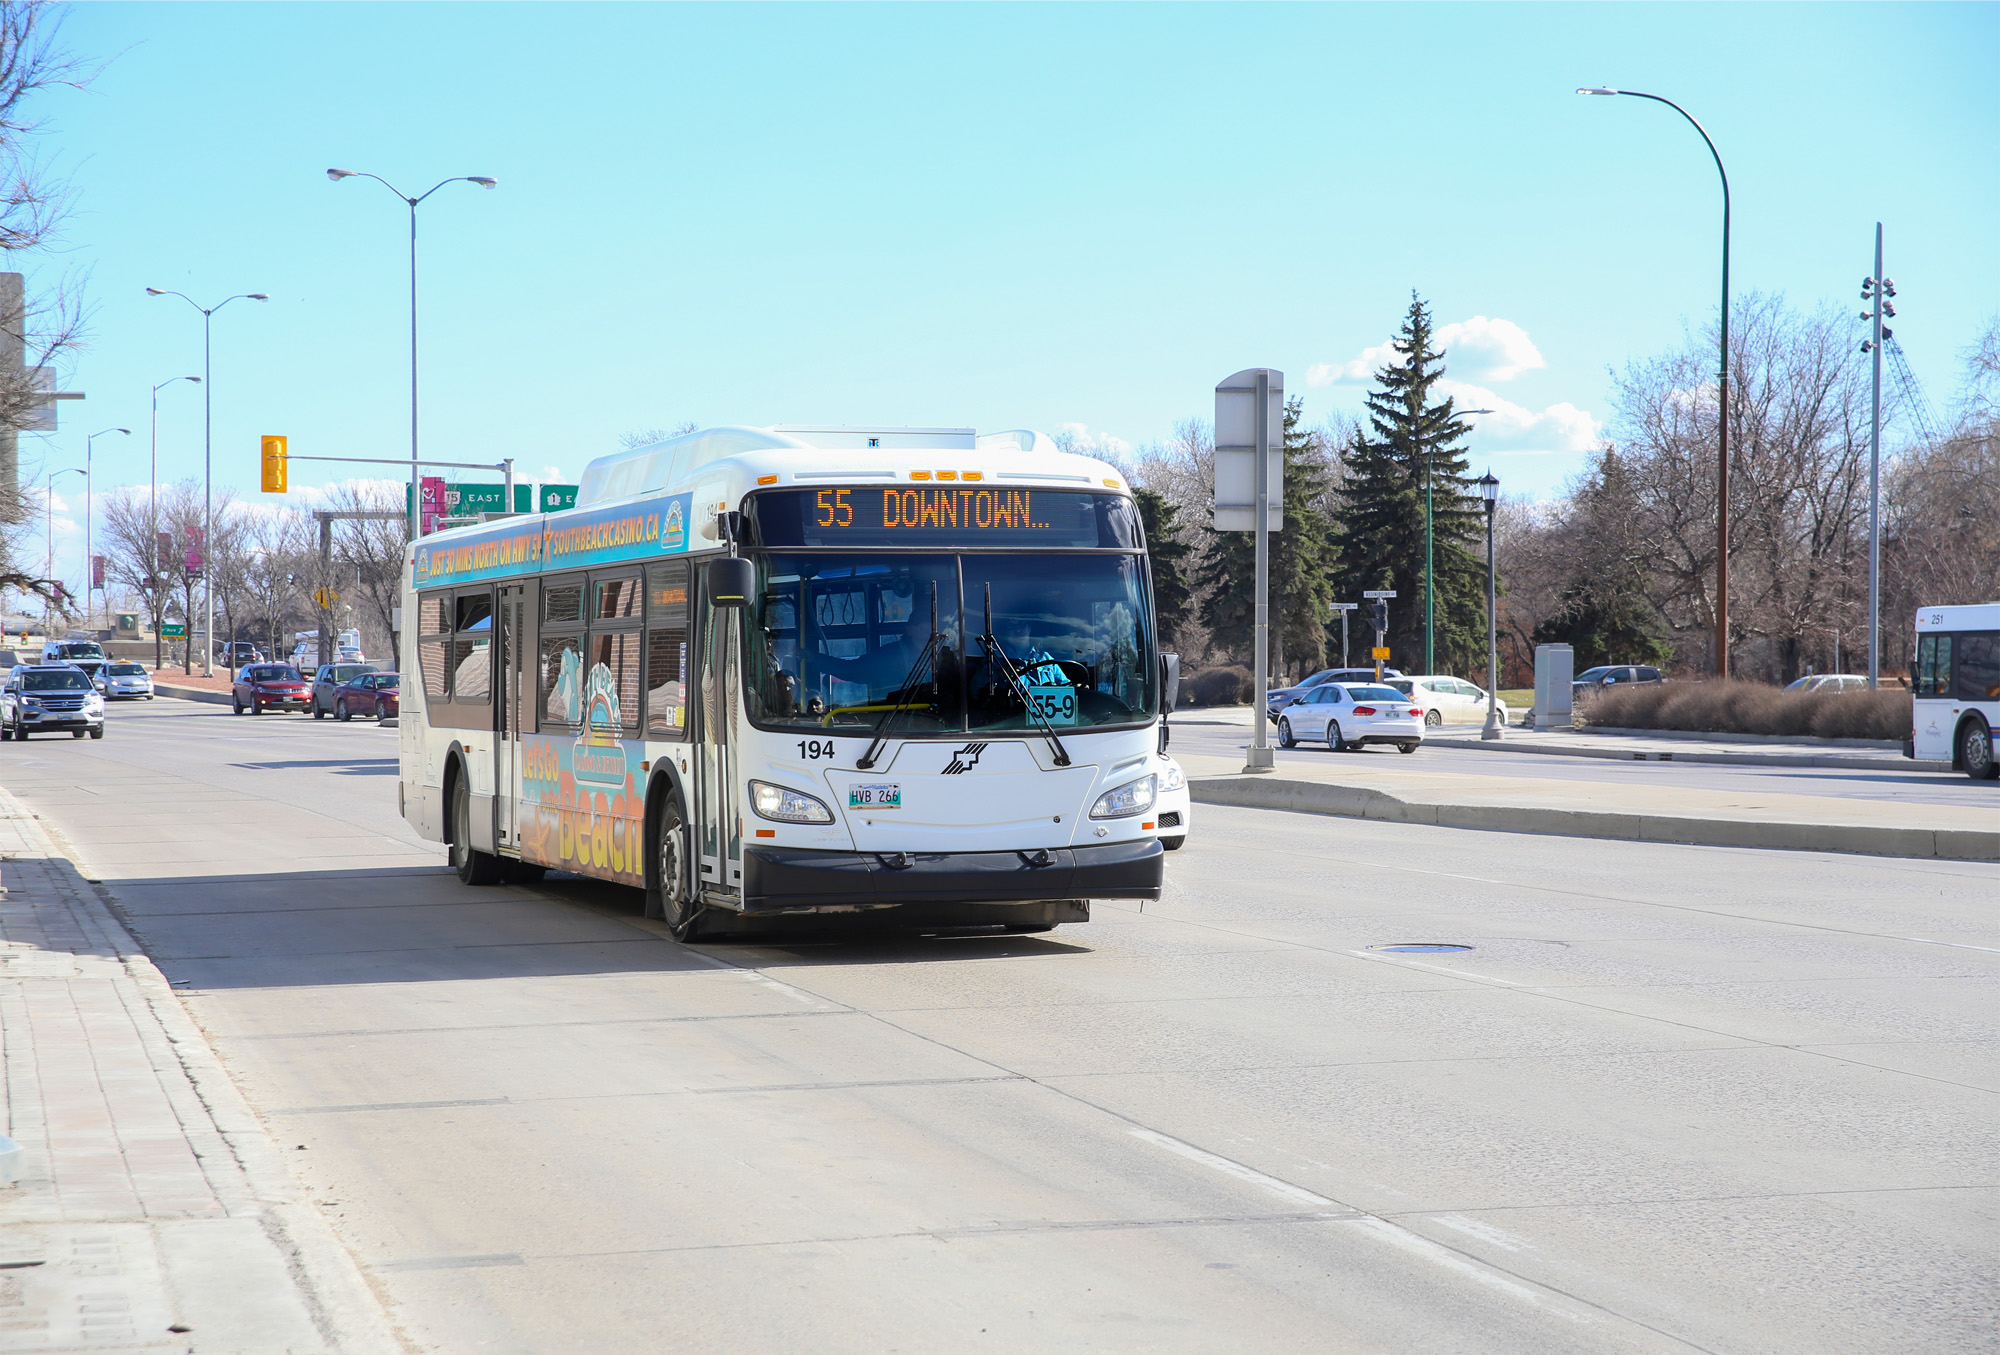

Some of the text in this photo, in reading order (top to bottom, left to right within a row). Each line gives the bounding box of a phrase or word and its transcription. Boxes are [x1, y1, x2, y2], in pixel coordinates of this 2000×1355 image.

[468, 494, 500, 502] EAST
[817, 489, 1050, 528] 55 DOWNTOWN...
[430, 550, 446, 576] JUST
[446, 548, 455, 574] 30
[455, 545, 474, 573] MINS
[474, 540, 499, 570] NORTH
[500, 538, 512, 567] ON
[512, 534, 531, 564] HWY
[553, 513, 660, 557] SOUTHBEACHCASINO.CA
[1931, 614, 1944, 625] 251
[1029, 694, 1074, 719] 55-9
[544, 741, 559, 783] Go
[797, 740, 835, 760] 194
[851, 790, 899, 803] HVB 266
[560, 770, 644, 876] Beach
